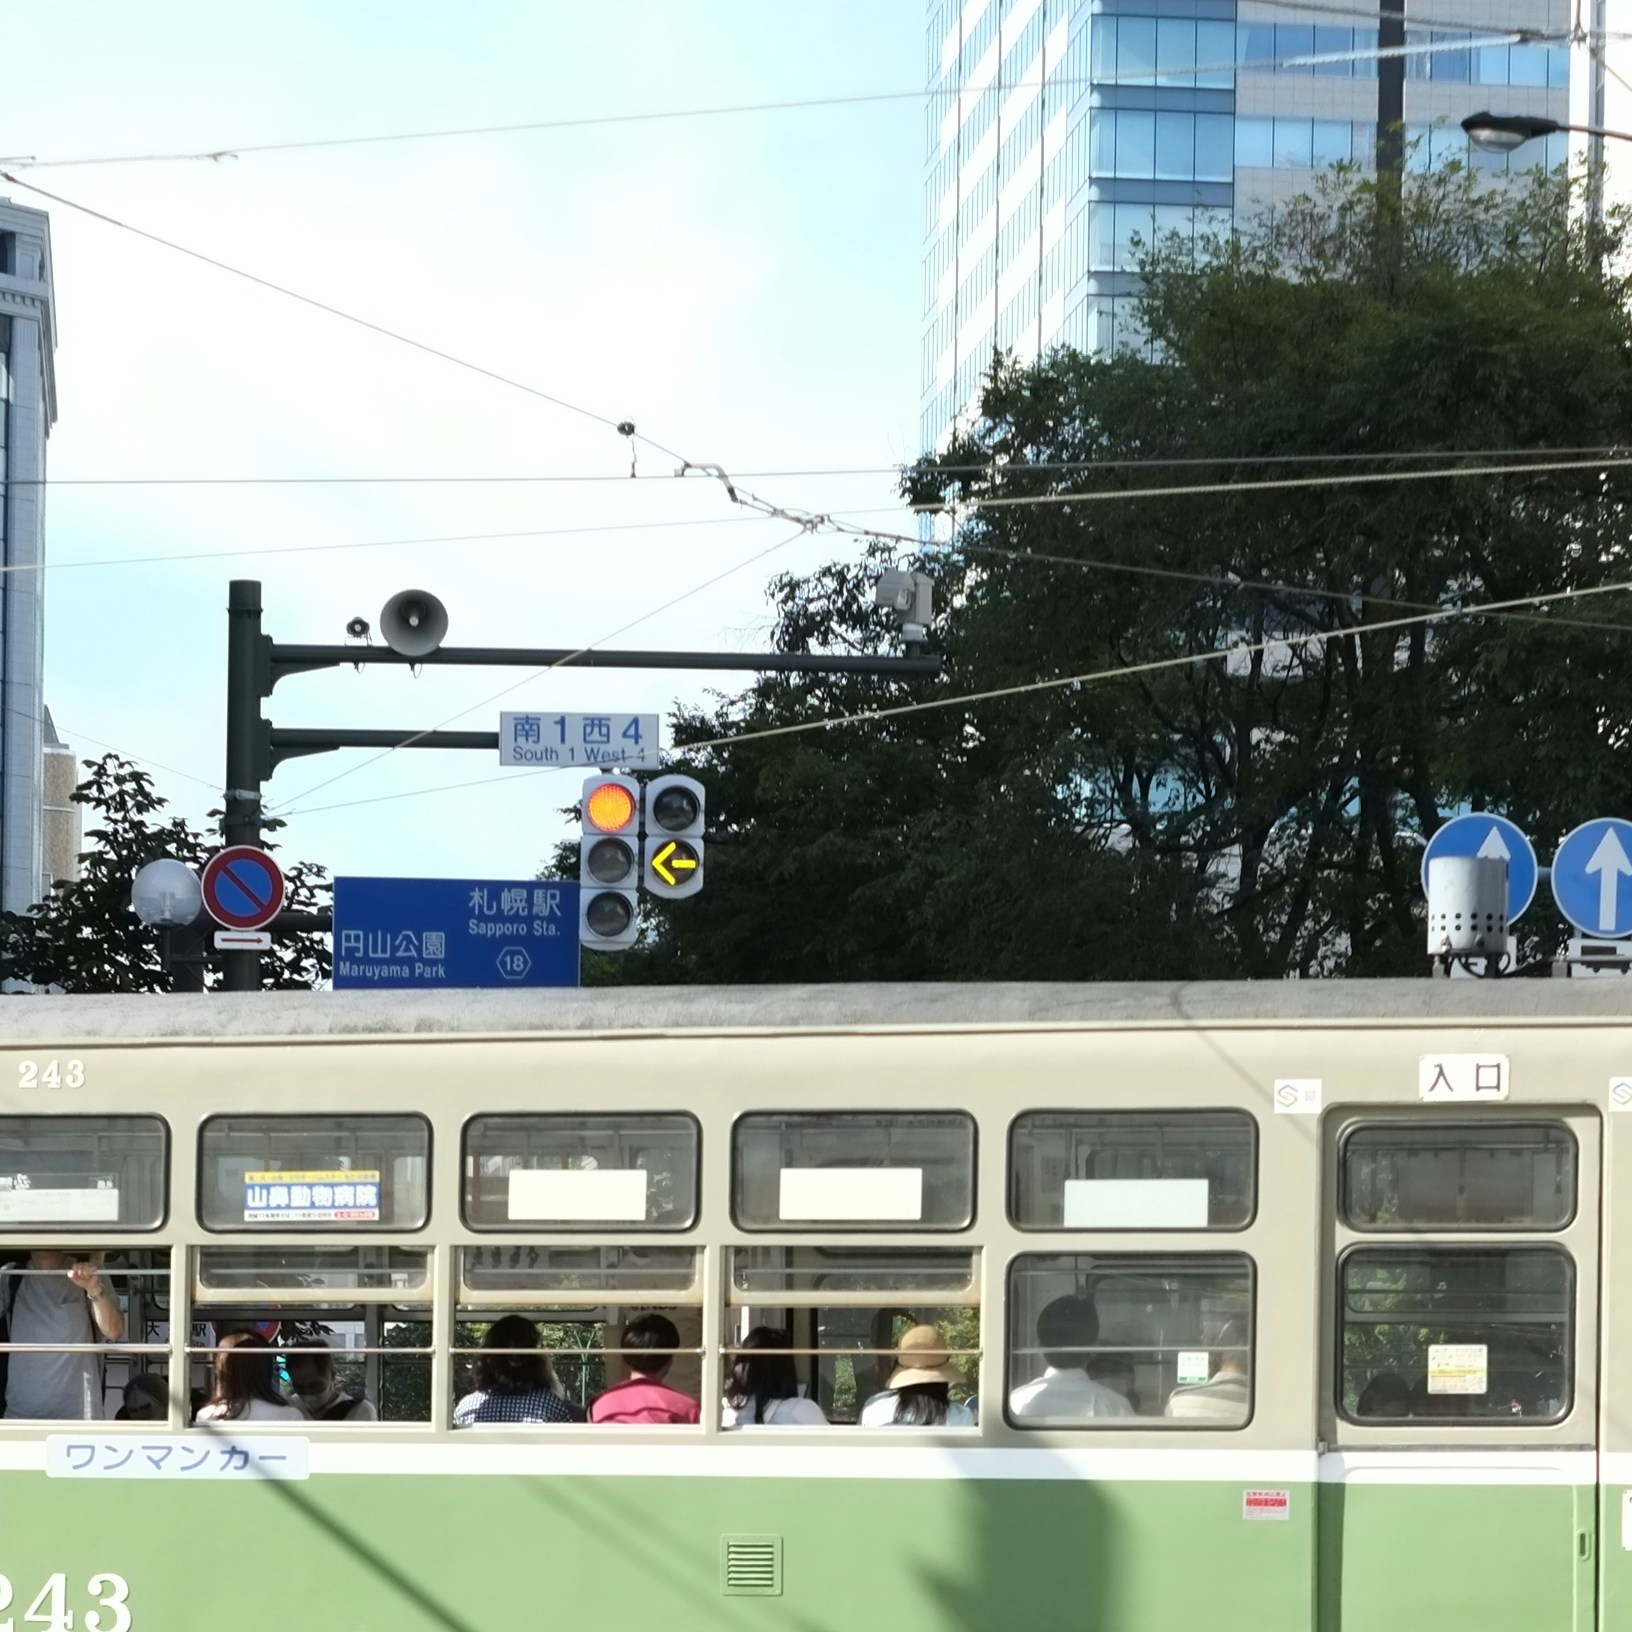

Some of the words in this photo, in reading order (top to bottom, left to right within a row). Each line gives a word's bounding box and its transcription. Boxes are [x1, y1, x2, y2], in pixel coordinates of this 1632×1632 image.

[513, 746, 559, 762] South
[585, 748, 627, 763] West
[636, 748, 646, 763] 4
[469, 887, 562, 917] 札幌駅
[469, 919, 527, 938] Sapporo
[533, 920, 561, 937] Sta.
[341, 929, 446, 959] 円山公園
[339, 961, 410, 981] Maruyama
[415, 963, 447, 979] Park
[502, 955, 524, 972] 18
[19, 1059, 86, 1089] 243
[1428, 1062, 1502, 1093] 入口
[65, 1444, 288, 1473] ワンマンカー
